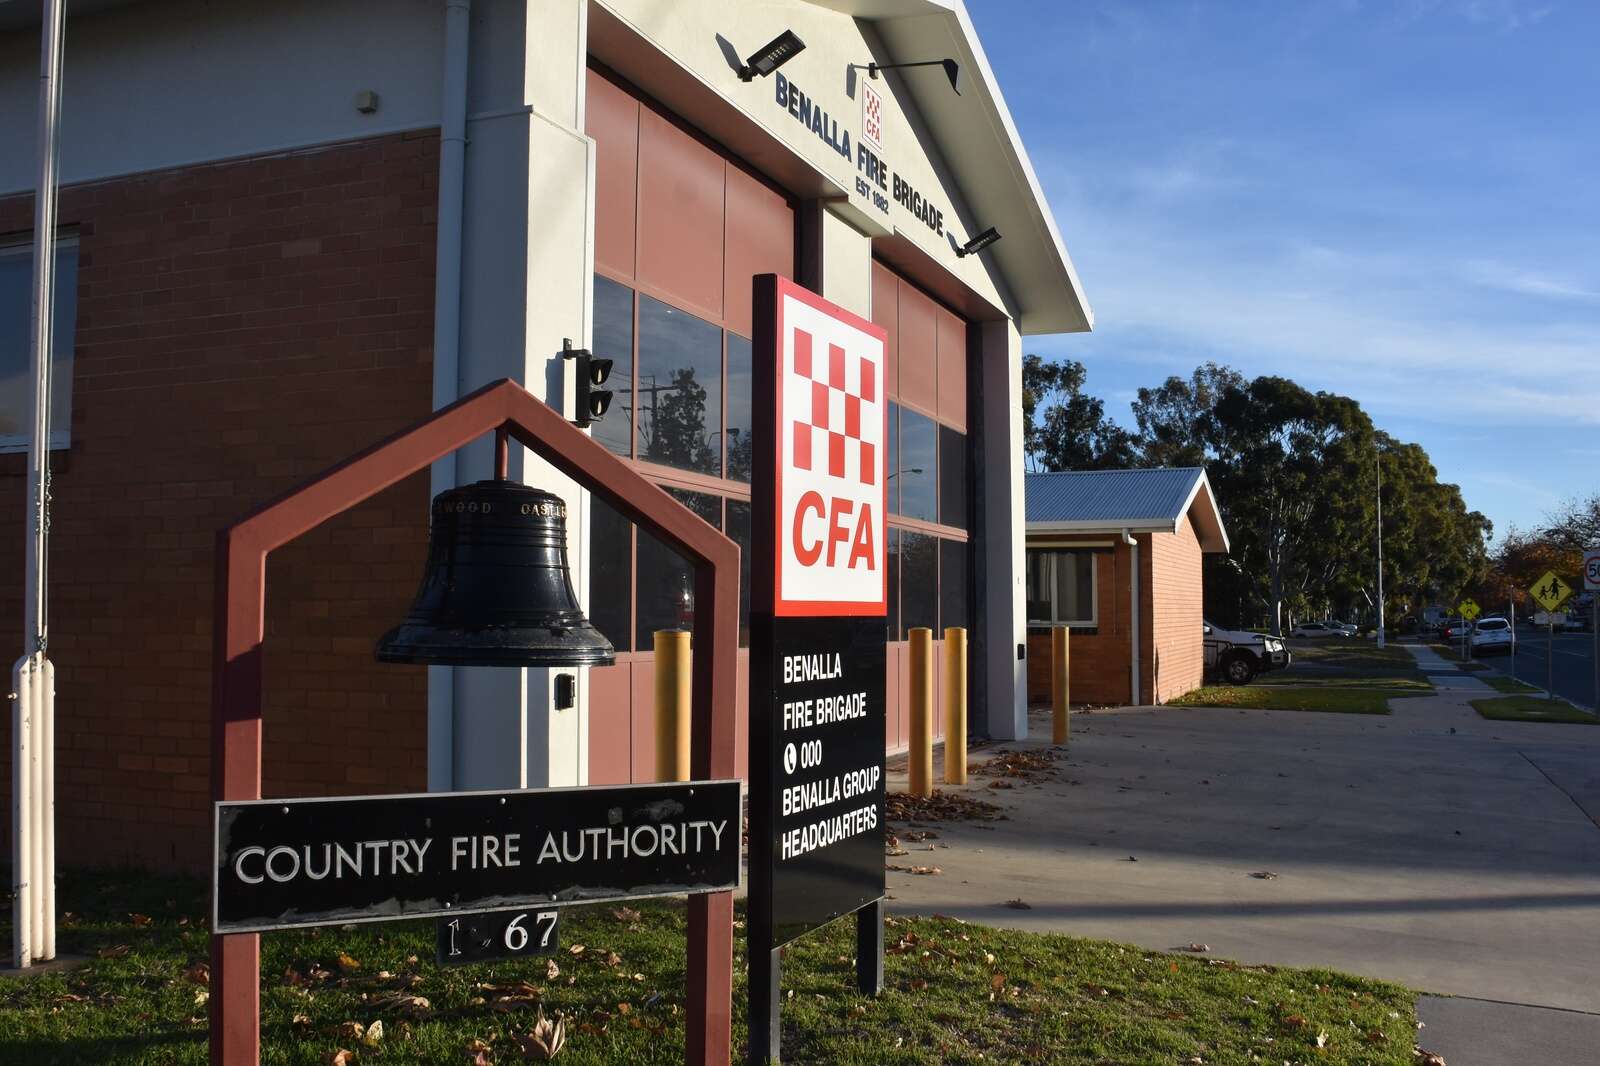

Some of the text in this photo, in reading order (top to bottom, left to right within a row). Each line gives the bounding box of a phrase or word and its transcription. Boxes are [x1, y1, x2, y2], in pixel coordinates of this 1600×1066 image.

[866, 118, 881, 142] CFA
[775, 70, 944, 237] BENALLA FIRE BRIGADE
[856, 175, 870, 201] EST
[792, 490, 876, 571] CFA
[783, 652, 842, 684] BENALLA
[783, 692, 867, 731] FIRE BRIGADE
[801, 739, 822, 769] 000
[782, 765, 880, 816] BENALLA GROUP
[235, 819, 728, 884] COUNTRY FIRE AUTHORITY
[782, 804, 877, 860] HEADQUARTERS
